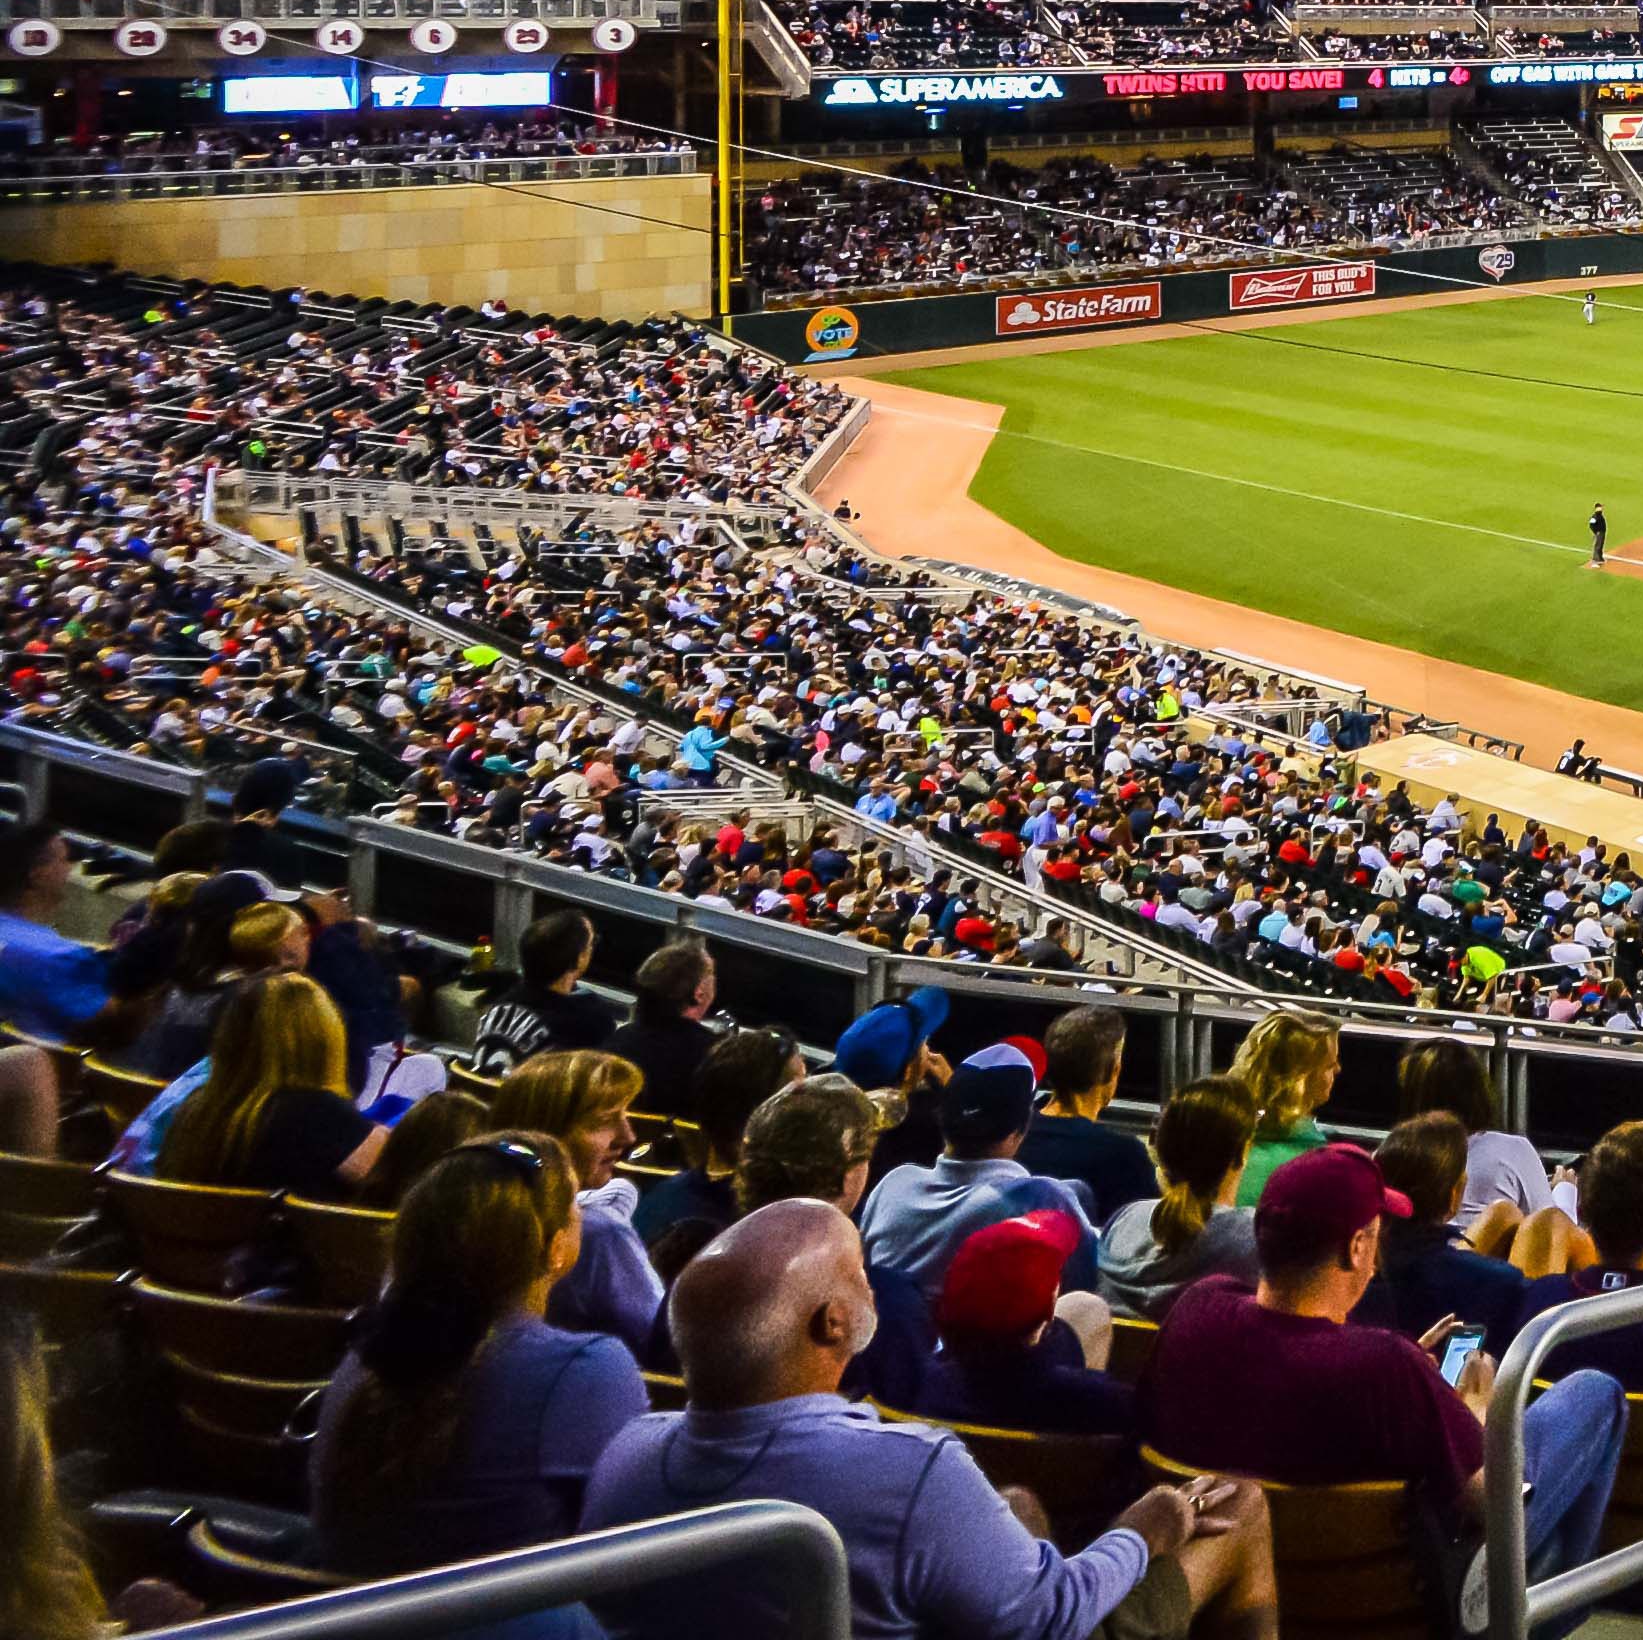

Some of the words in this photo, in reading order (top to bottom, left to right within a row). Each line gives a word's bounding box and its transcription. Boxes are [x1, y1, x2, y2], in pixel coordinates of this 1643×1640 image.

[228, 29, 258, 47] 34
[329, 29, 353, 46] 14
[430, 28, 441, 45] 6
[608, 27, 621, 44] 3
[879, 75, 1063, 103] SUPERAMERICA
[1103, 72, 1177, 95] TWINS
[1242, 71, 1287, 92] YOU
[1289, 70, 1344, 90] SAVE!
[1368, 67, 1385, 88] 4
[1496, 253, 1513, 269] 29
[1312, 269, 1336, 283] THIS
[1580, 265, 1599, 277] 377
[1312, 283, 1333, 296] FOR
